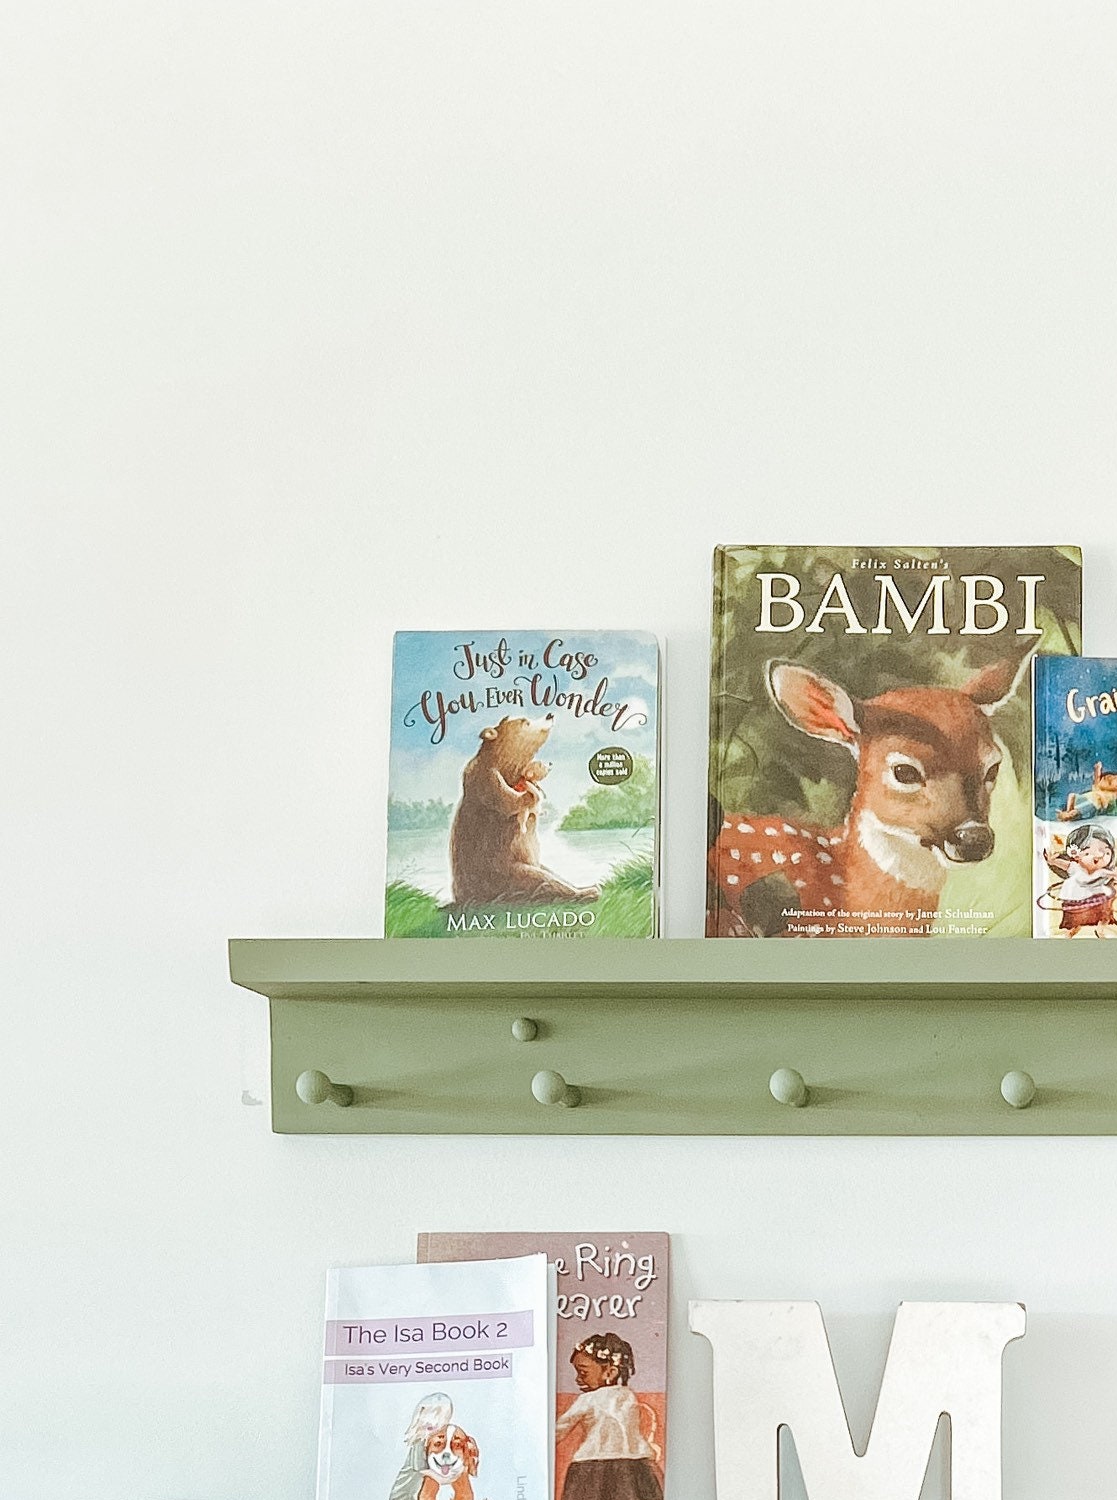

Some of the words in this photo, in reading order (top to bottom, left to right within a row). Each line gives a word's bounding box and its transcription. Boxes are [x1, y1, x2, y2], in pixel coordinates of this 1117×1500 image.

[851, 558, 887, 570] Felix
[894, 558, 949, 570] Salten's
[754, 573, 1046, 635] BAMBI
[453, 638, 511, 680] Just
[519, 650, 538, 670] in
[542, 639, 598, 680] Case
[404, 689, 484, 744] You
[514, 674, 648, 731] Wonder
[447, 913, 496, 931] MAX
[506, 911, 596, 929] LUCADO
[781, 908, 825, 918] Adaptation
[827, 908, 837, 917] of
[837, 909, 850, 918] the
[852, 909, 882, 920] original
[905, 910, 914, 919] by
[916, 909, 942, 920] Janet
[945, 909, 994, 919] Schulman
[787, 923, 824, 934] Paintings
[825, 924, 835, 934] by
[837, 923, 864, 933] Steve
[865, 923, 907, 935] Johnson
[909, 925, 923, 933] and
[926, 924, 945, 933] Lou
[575, 1243, 658, 1290] Ring
[557, 1293, 642, 1321] earer
[343, 1325, 387, 1344] The
[394, 1324, 424, 1343] Isa
[432, 1320, 490, 1341] Book
[496, 1322, 508, 1338] 2
[345, 1362, 375, 1376] Isa's
[379, 1362, 412, 1378] Very
[415, 1359, 469, 1374] Second
[473, 1357, 509, 1371] Book
